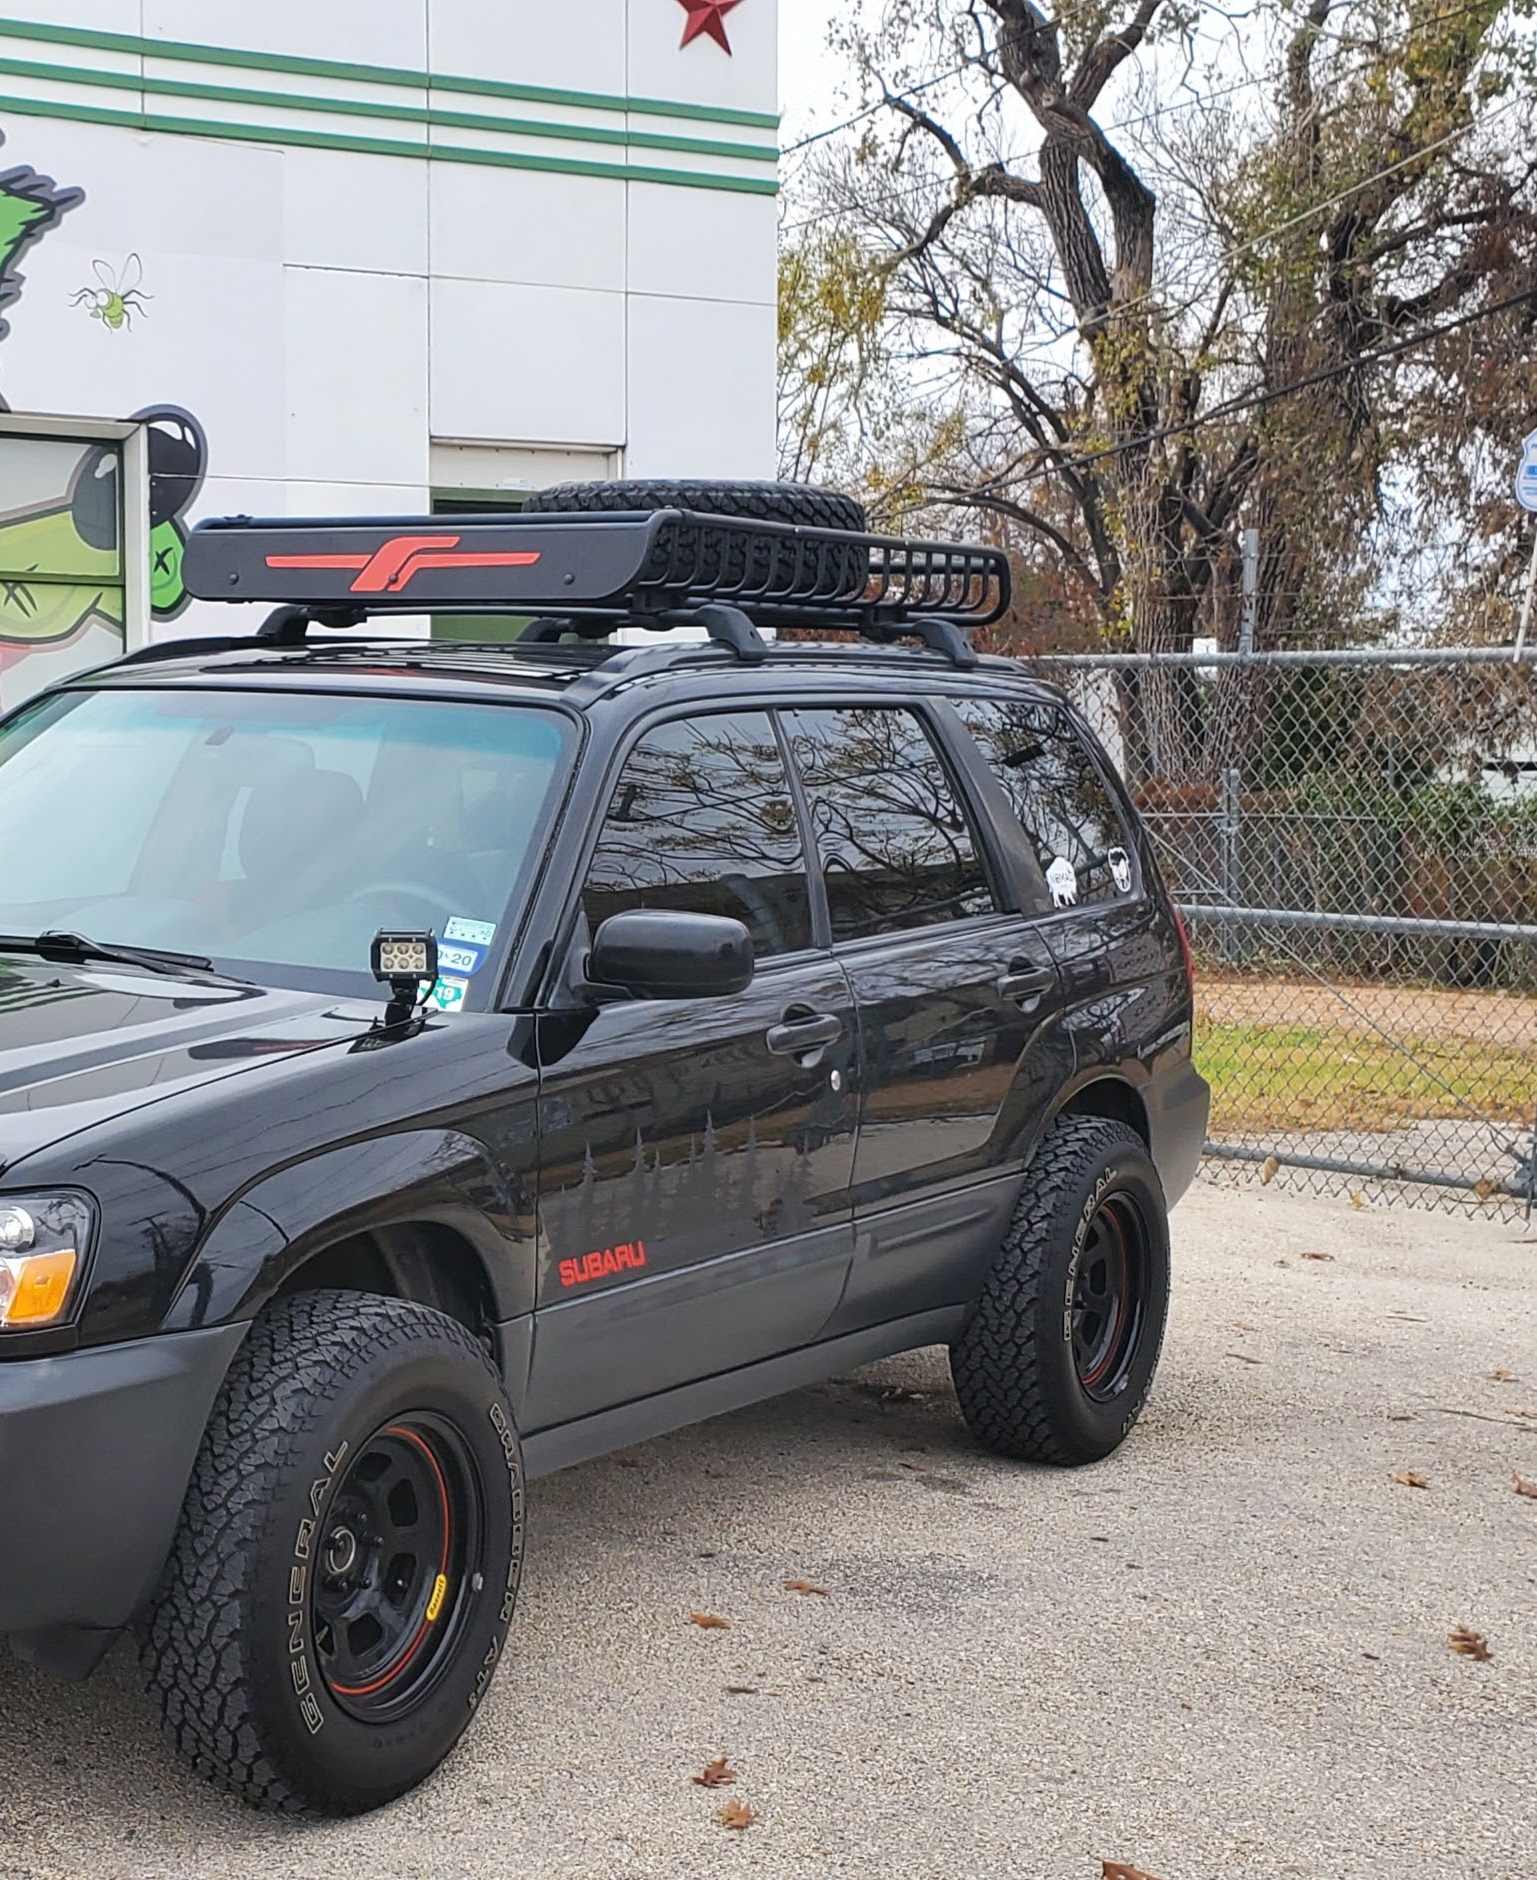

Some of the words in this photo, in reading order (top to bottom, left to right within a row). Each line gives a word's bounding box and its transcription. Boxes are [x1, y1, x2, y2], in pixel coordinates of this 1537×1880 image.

[436, 986, 455, 1001] 19
[450, 952, 472, 967] 20
[558, 1239, 647, 1287] SUBARU
[1063, 1168, 1117, 1341] GENERAL
[489, 1402, 526, 1622] GRABBER
[288, 1440, 349, 1735] GENERAL
